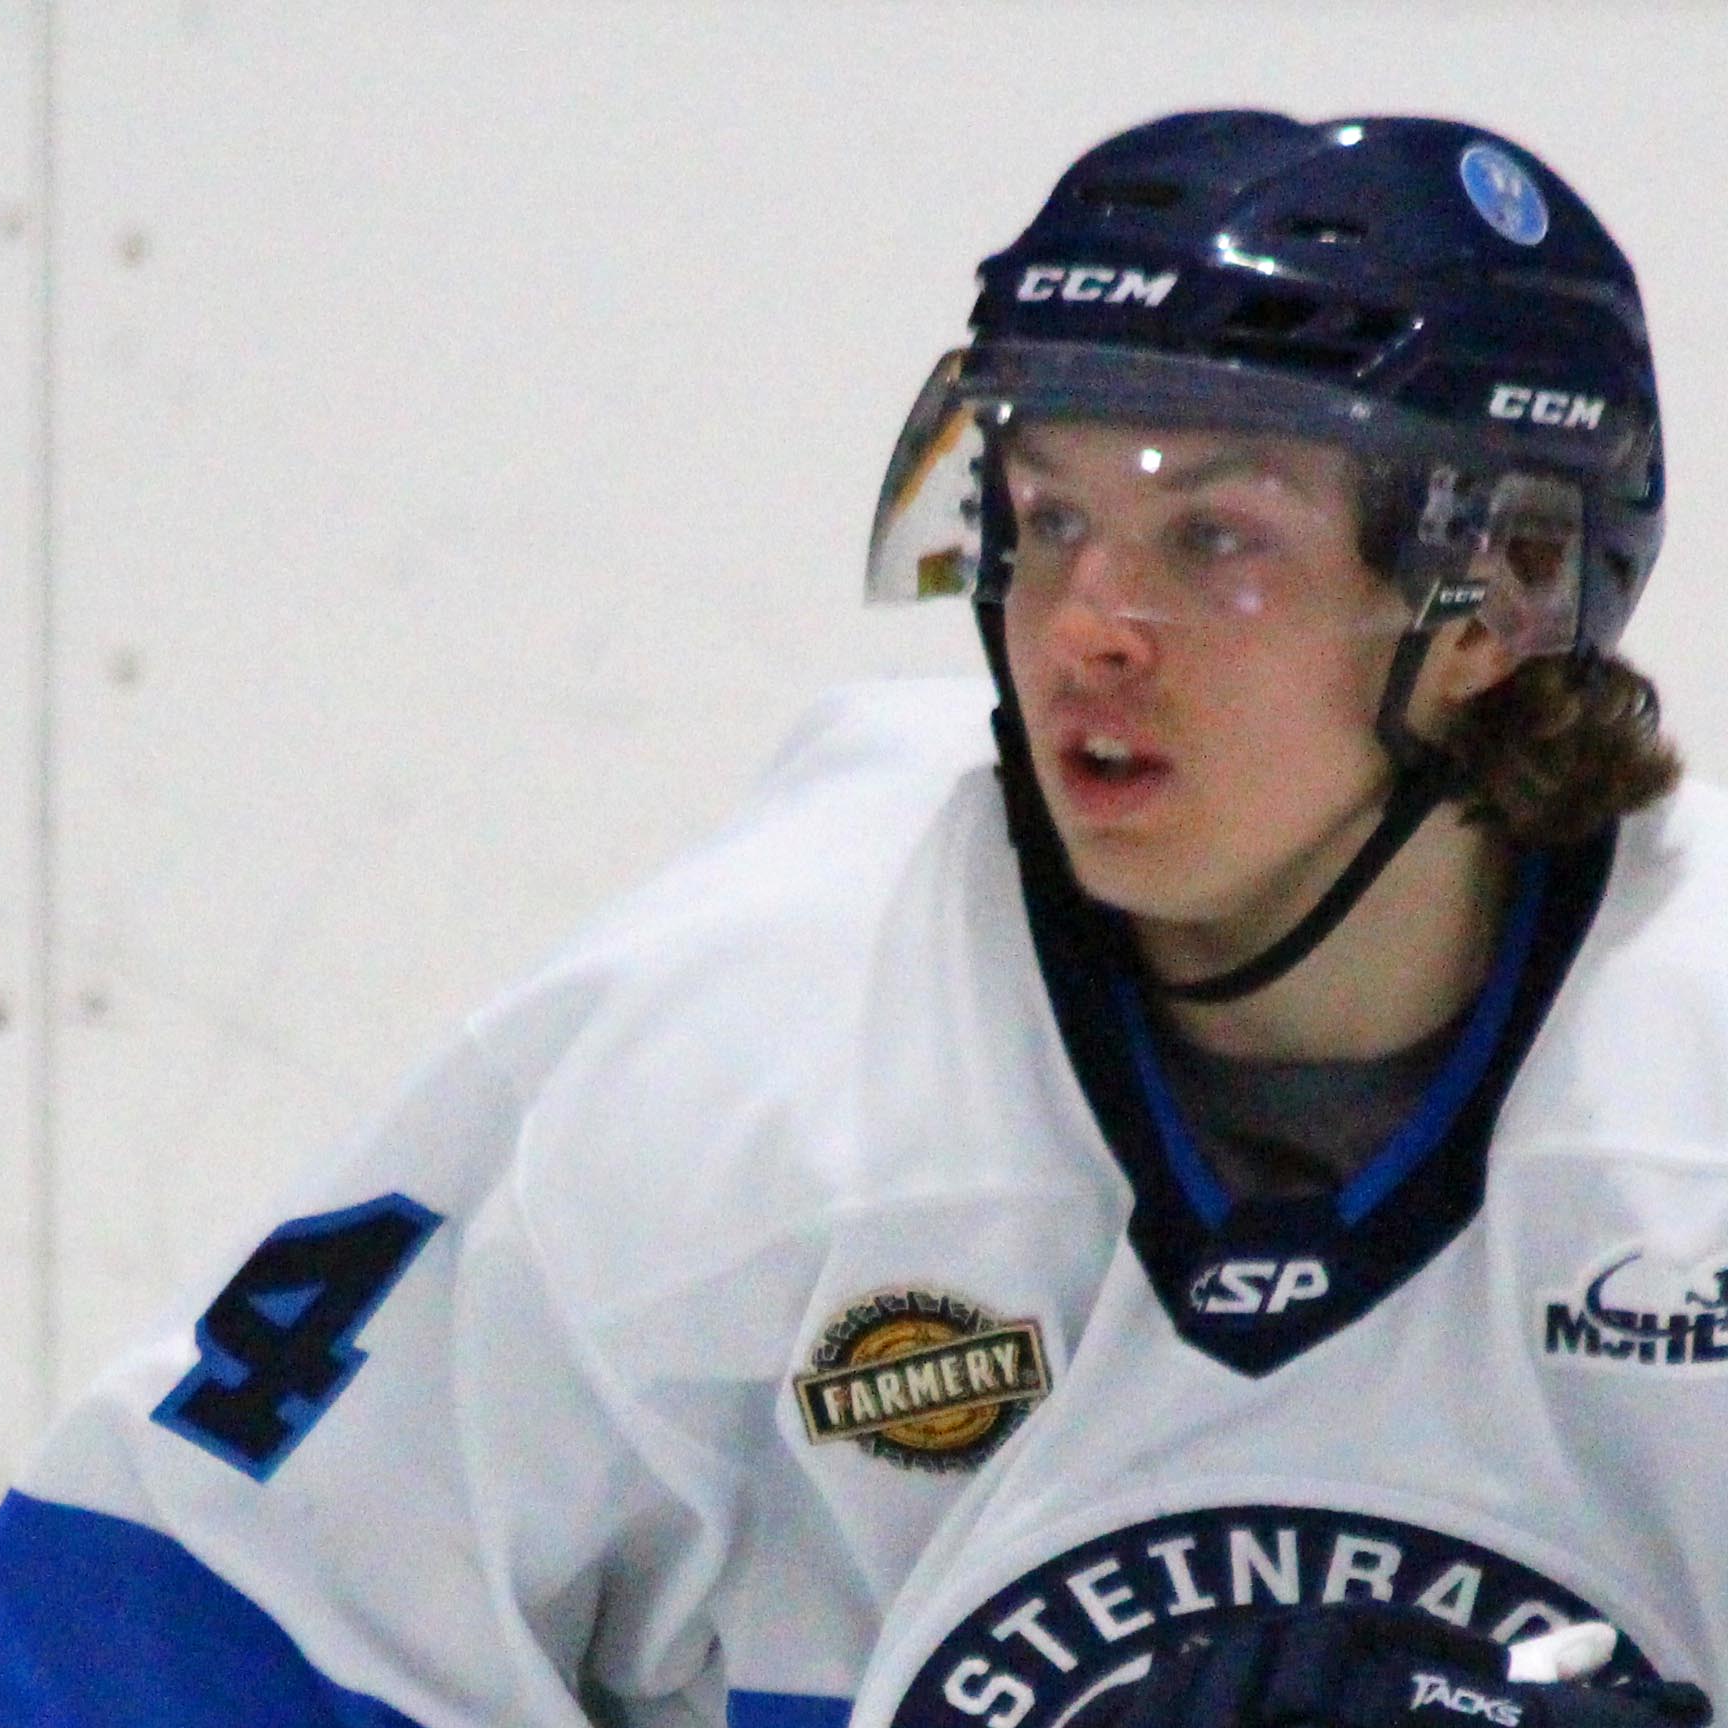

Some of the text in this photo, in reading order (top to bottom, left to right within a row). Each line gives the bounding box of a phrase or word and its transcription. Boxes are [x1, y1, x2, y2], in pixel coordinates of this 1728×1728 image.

[1016, 265, 1181, 308] CCM
[1488, 384, 1606, 431] CCM
[1203, 1260, 1331, 1314] SP
[149, 1192, 448, 1485] 4
[822, 1341, 1022, 1425] FARMERY
